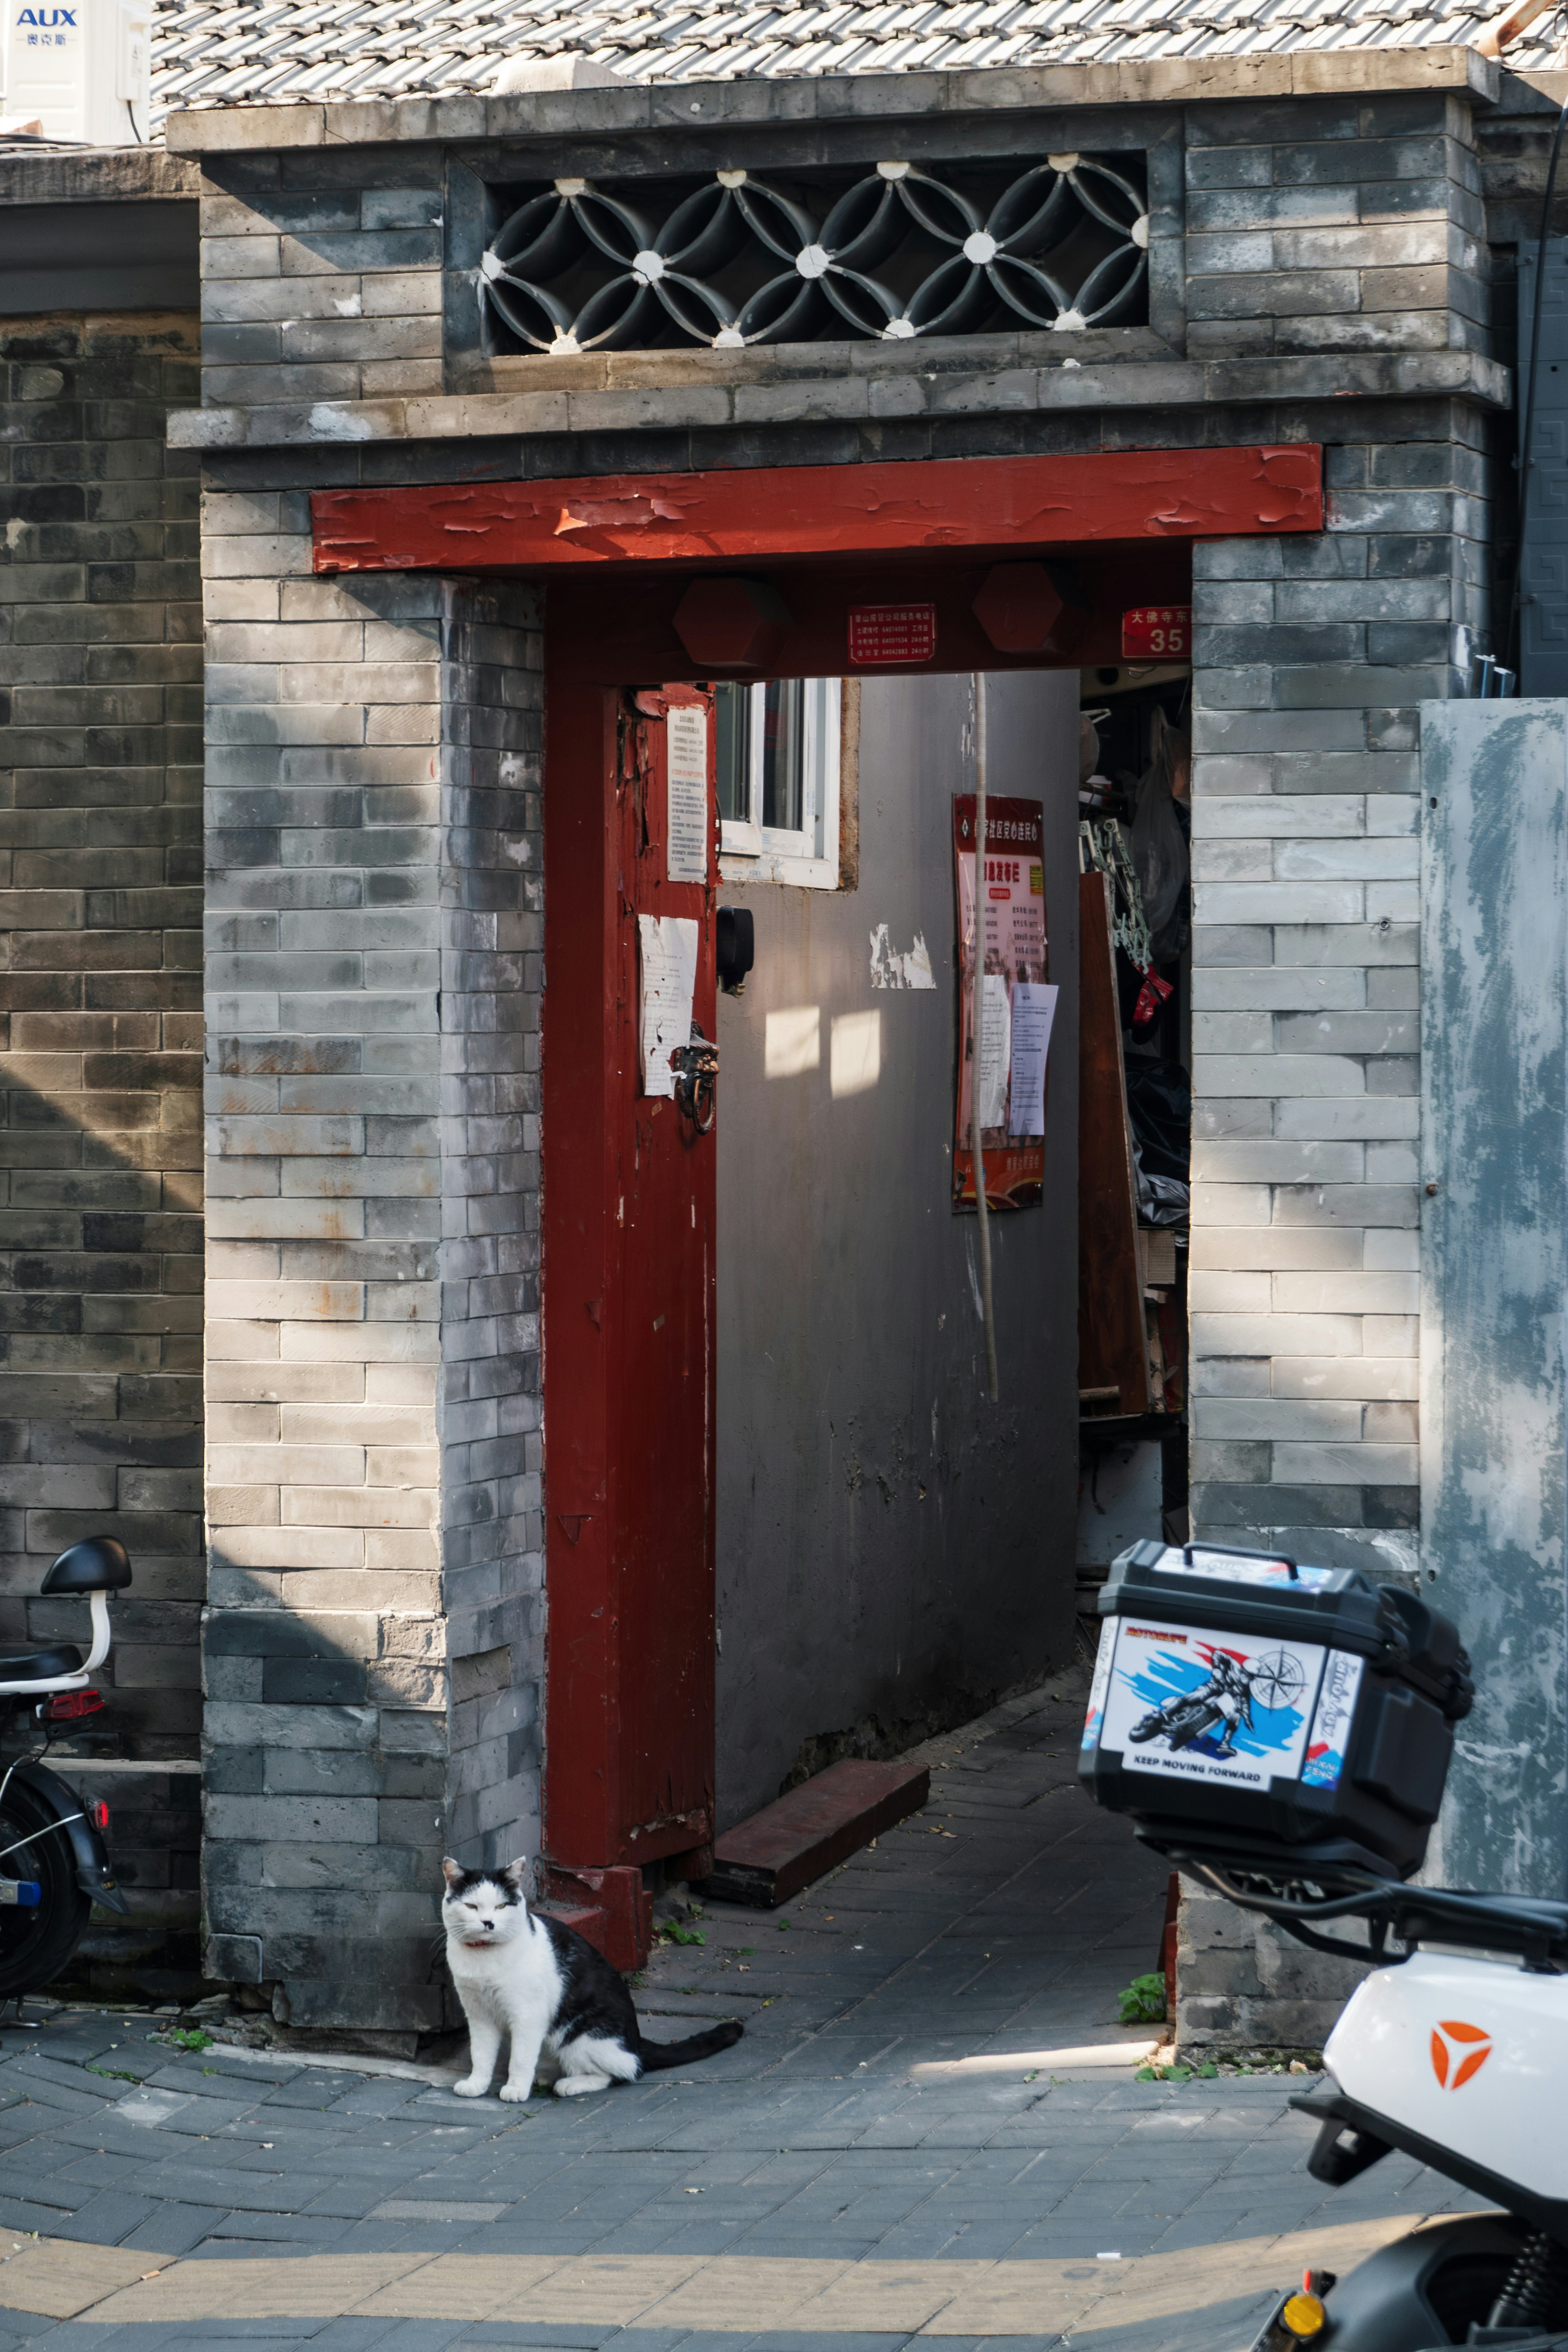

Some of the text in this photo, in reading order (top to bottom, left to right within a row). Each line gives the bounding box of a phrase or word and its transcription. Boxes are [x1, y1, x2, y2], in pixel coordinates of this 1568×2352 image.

[16, 9, 77, 26] AUX
[27, 34, 65, 45] 奥克斯
[1131, 611, 1188, 623] 大佛寺东
[1150, 629, 1183, 652] 35
[974, 819, 1037, 841] 社区党心连民心
[1134, 1754, 1261, 1782] KEEP MOVING FORWARD
